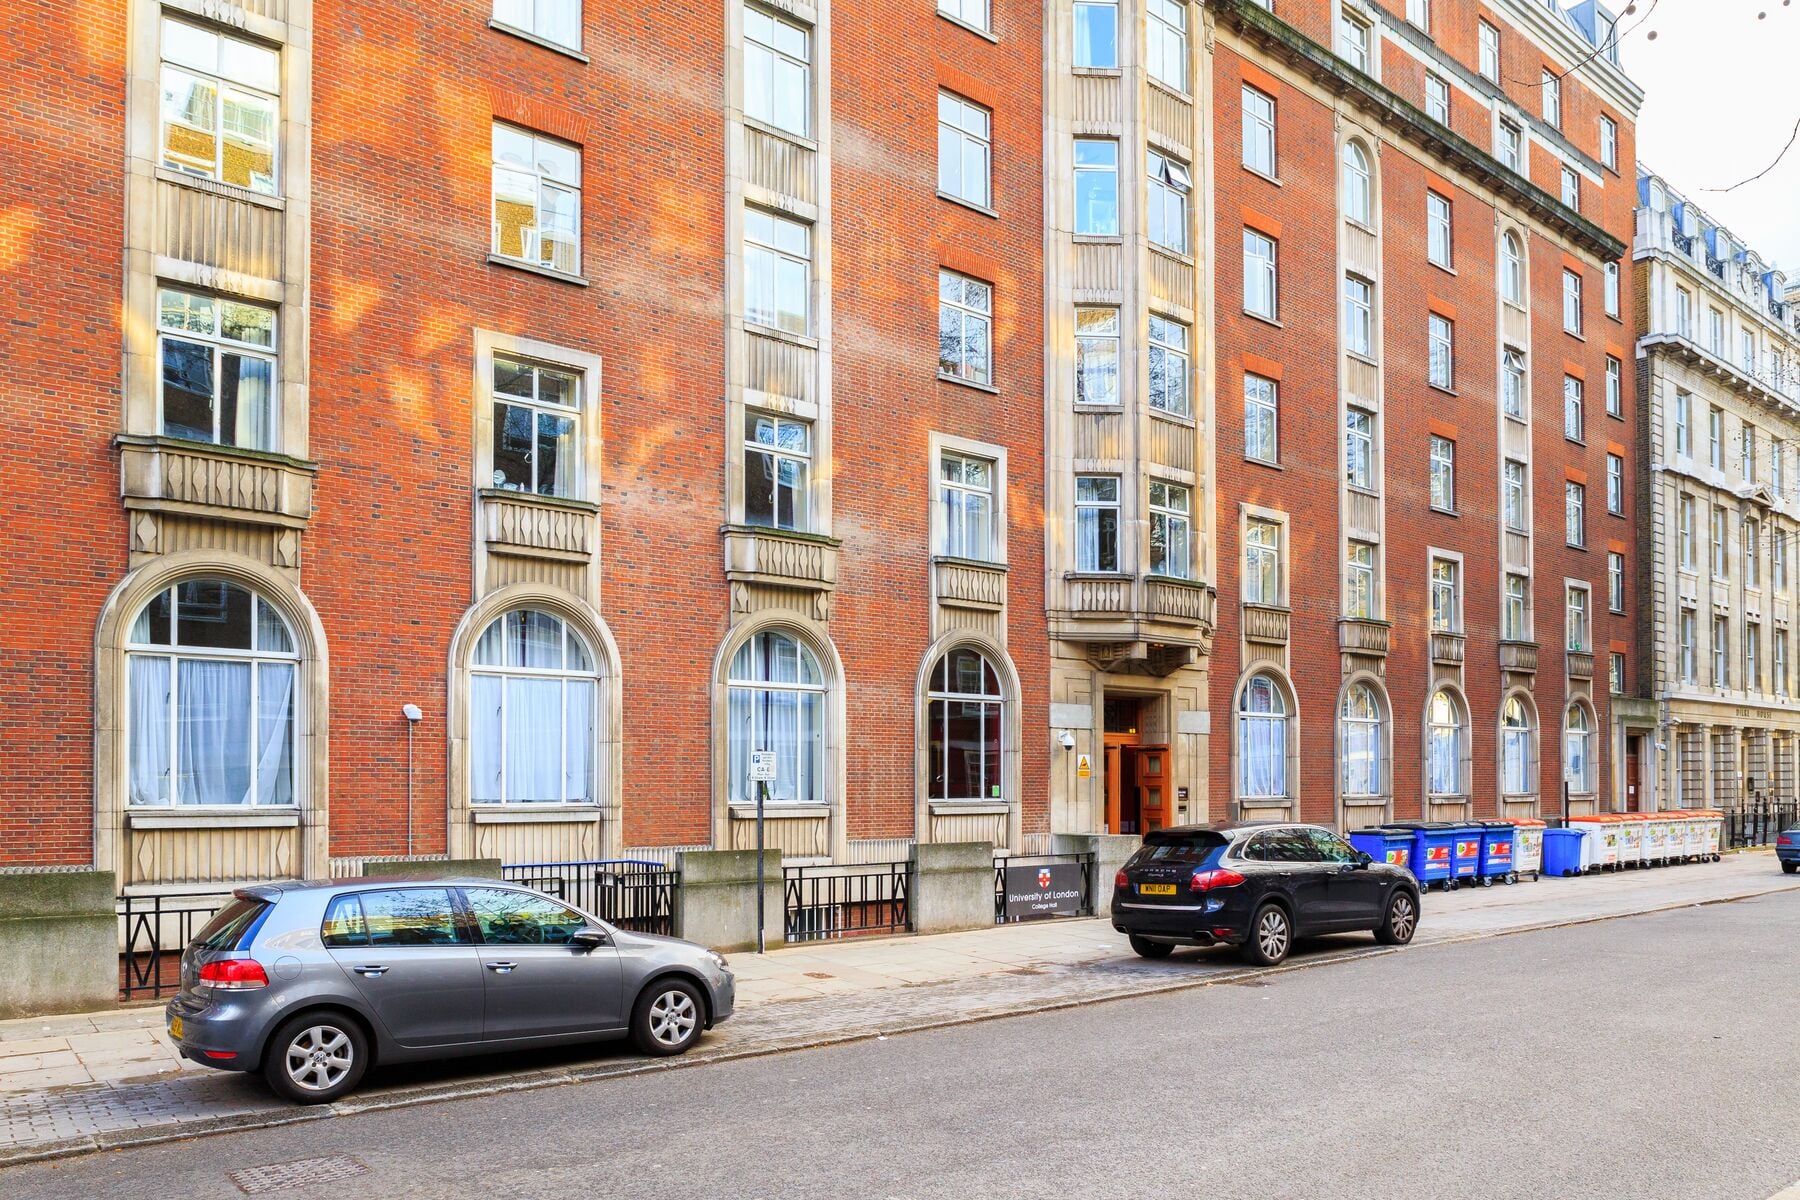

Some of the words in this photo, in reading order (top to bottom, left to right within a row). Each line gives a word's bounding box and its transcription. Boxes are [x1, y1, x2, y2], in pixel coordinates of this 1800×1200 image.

[1009, 892, 1042, 903] University
[1044, 891, 1051, 900] of
[1053, 889, 1079, 899] London
[1031, 902, 1048, 910] College
